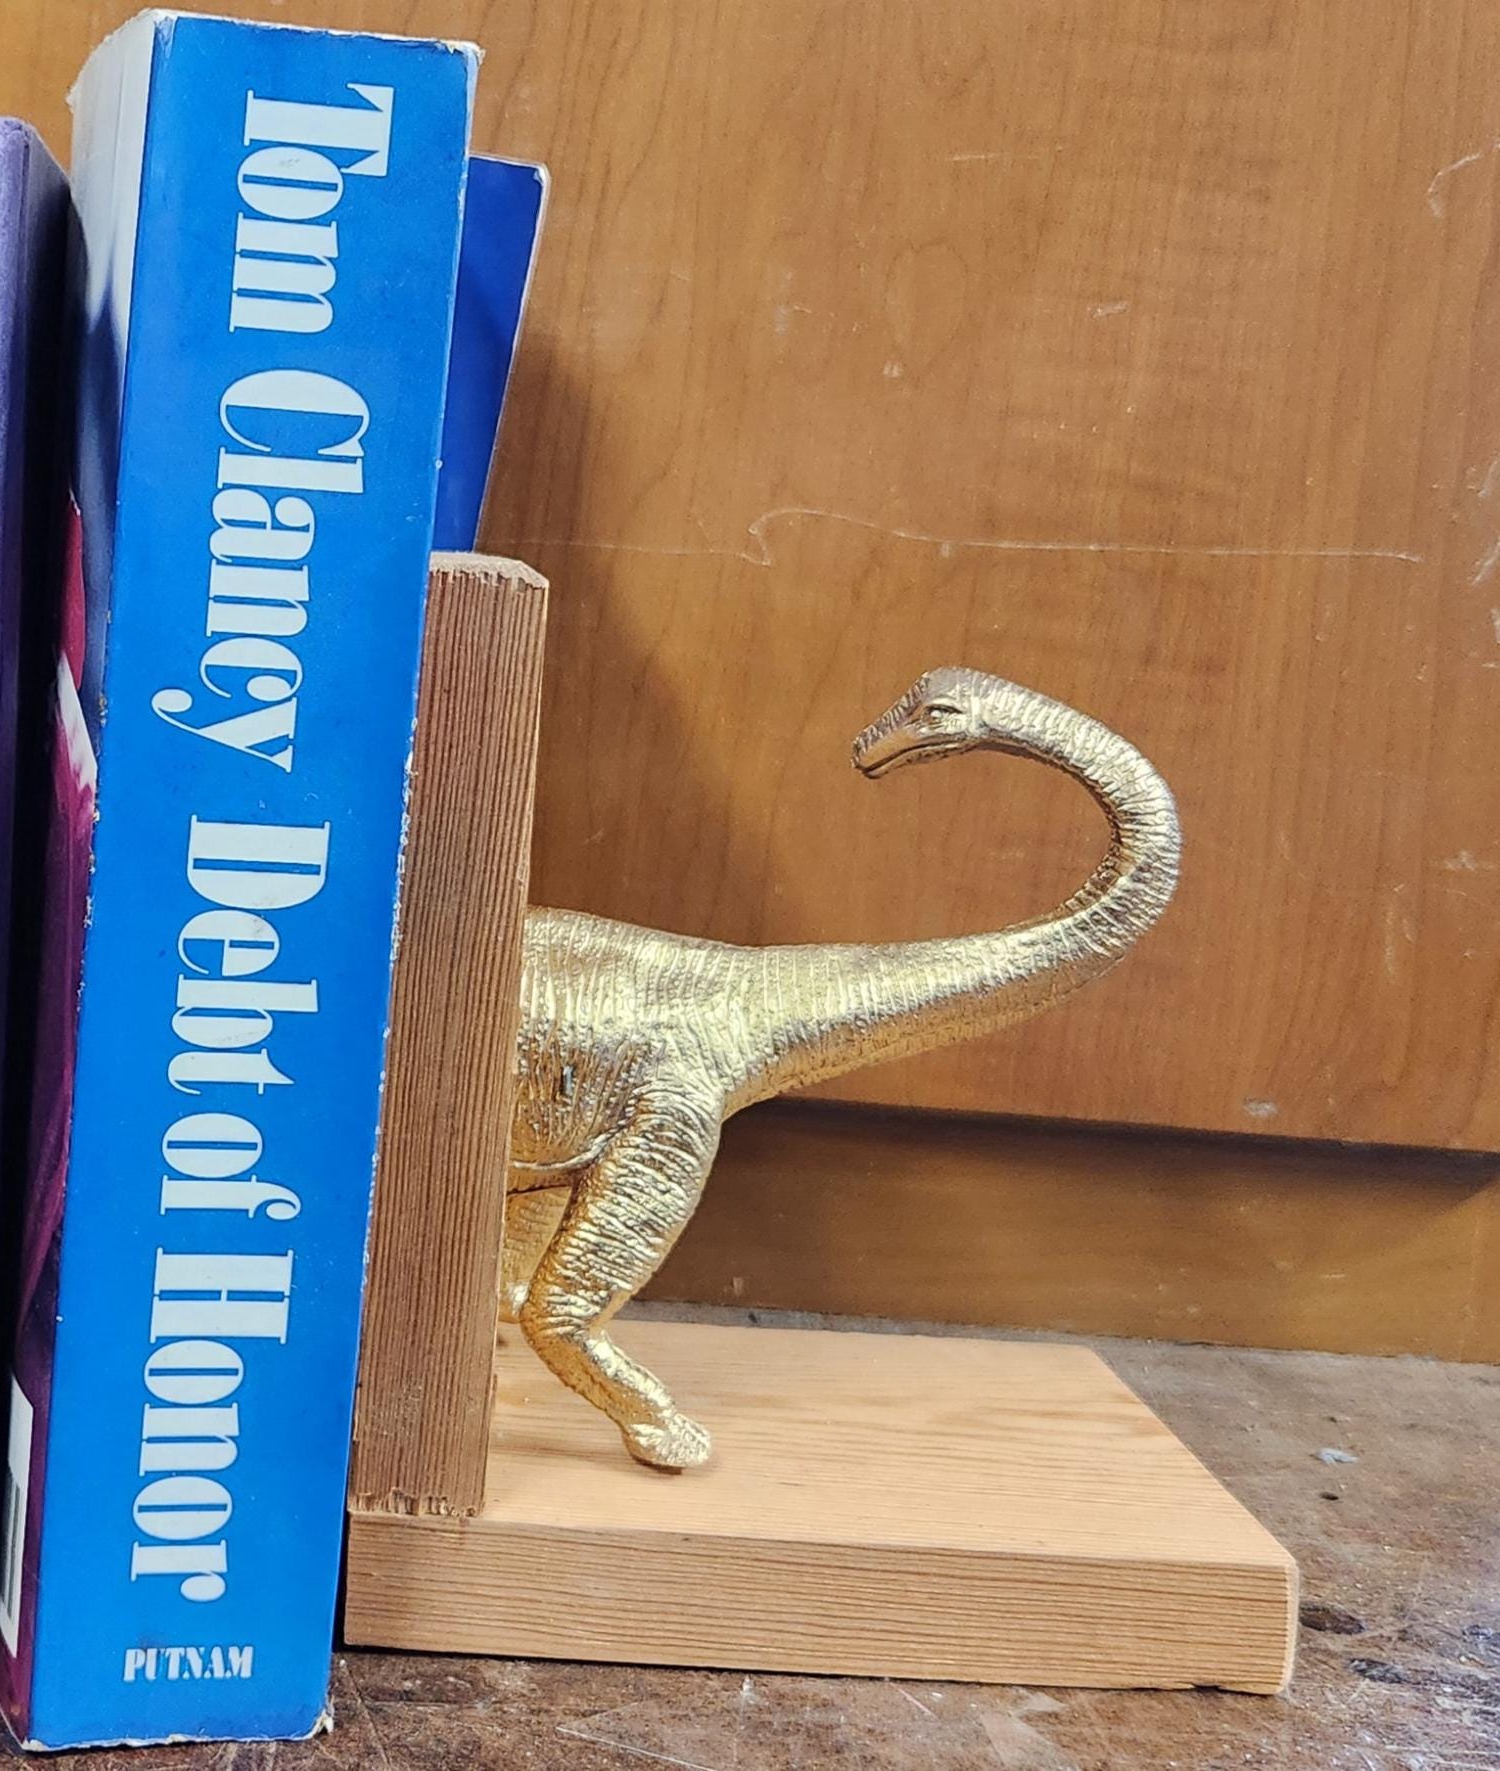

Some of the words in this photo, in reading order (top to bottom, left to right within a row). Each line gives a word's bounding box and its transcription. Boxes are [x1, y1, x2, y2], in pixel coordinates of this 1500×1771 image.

[229, 82, 395, 335] Tom
[150, 368, 371, 774] Clancy
[166, 812, 332, 1095] Debt
[159, 1112, 302, 1222] of
[128, 1247, 295, 1604] Honor
[123, 1645, 254, 1682] PUTNAM
